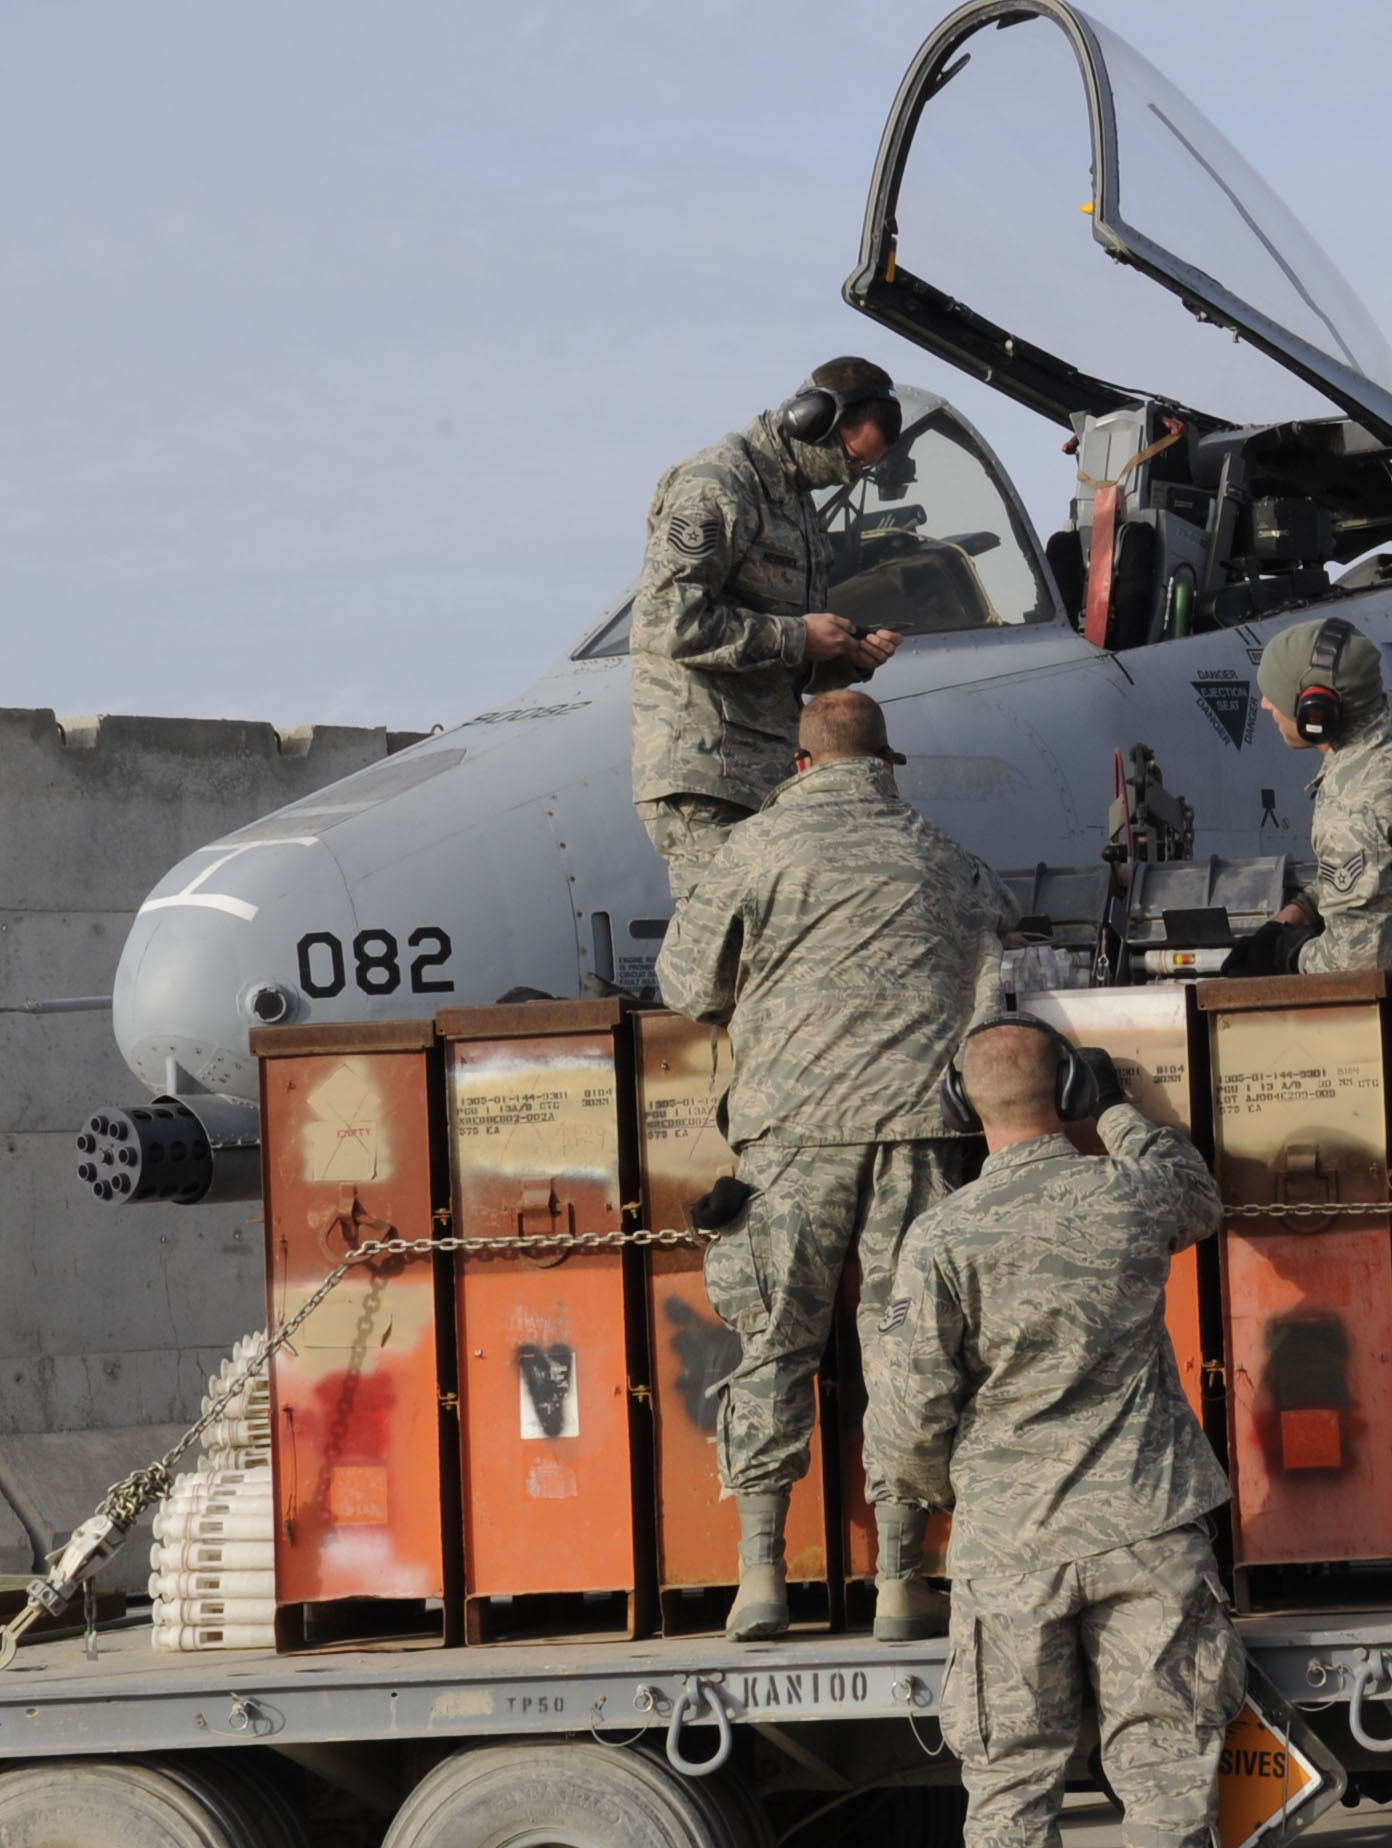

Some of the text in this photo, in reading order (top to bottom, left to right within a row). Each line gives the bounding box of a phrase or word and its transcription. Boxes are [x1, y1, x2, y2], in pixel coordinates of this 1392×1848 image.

[1197, 670, 1238, 680] DANGER
[1201, 687, 1247, 698] EJECTION
[1216, 700, 1240, 711] SEAT
[1196, 697, 1231, 746] DANGER
[1244, 696, 1258, 745] DANGER
[297, 926, 455, 999] 082
[539, 1101, 560, 1111] CTG
[649, 1097, 718, 1110] 1305-01-14
[336, 1127, 372, 1138] EMPTY
[507, 1696, 564, 1713] TP50
[1219, 1748, 1286, 1779] SIVES
